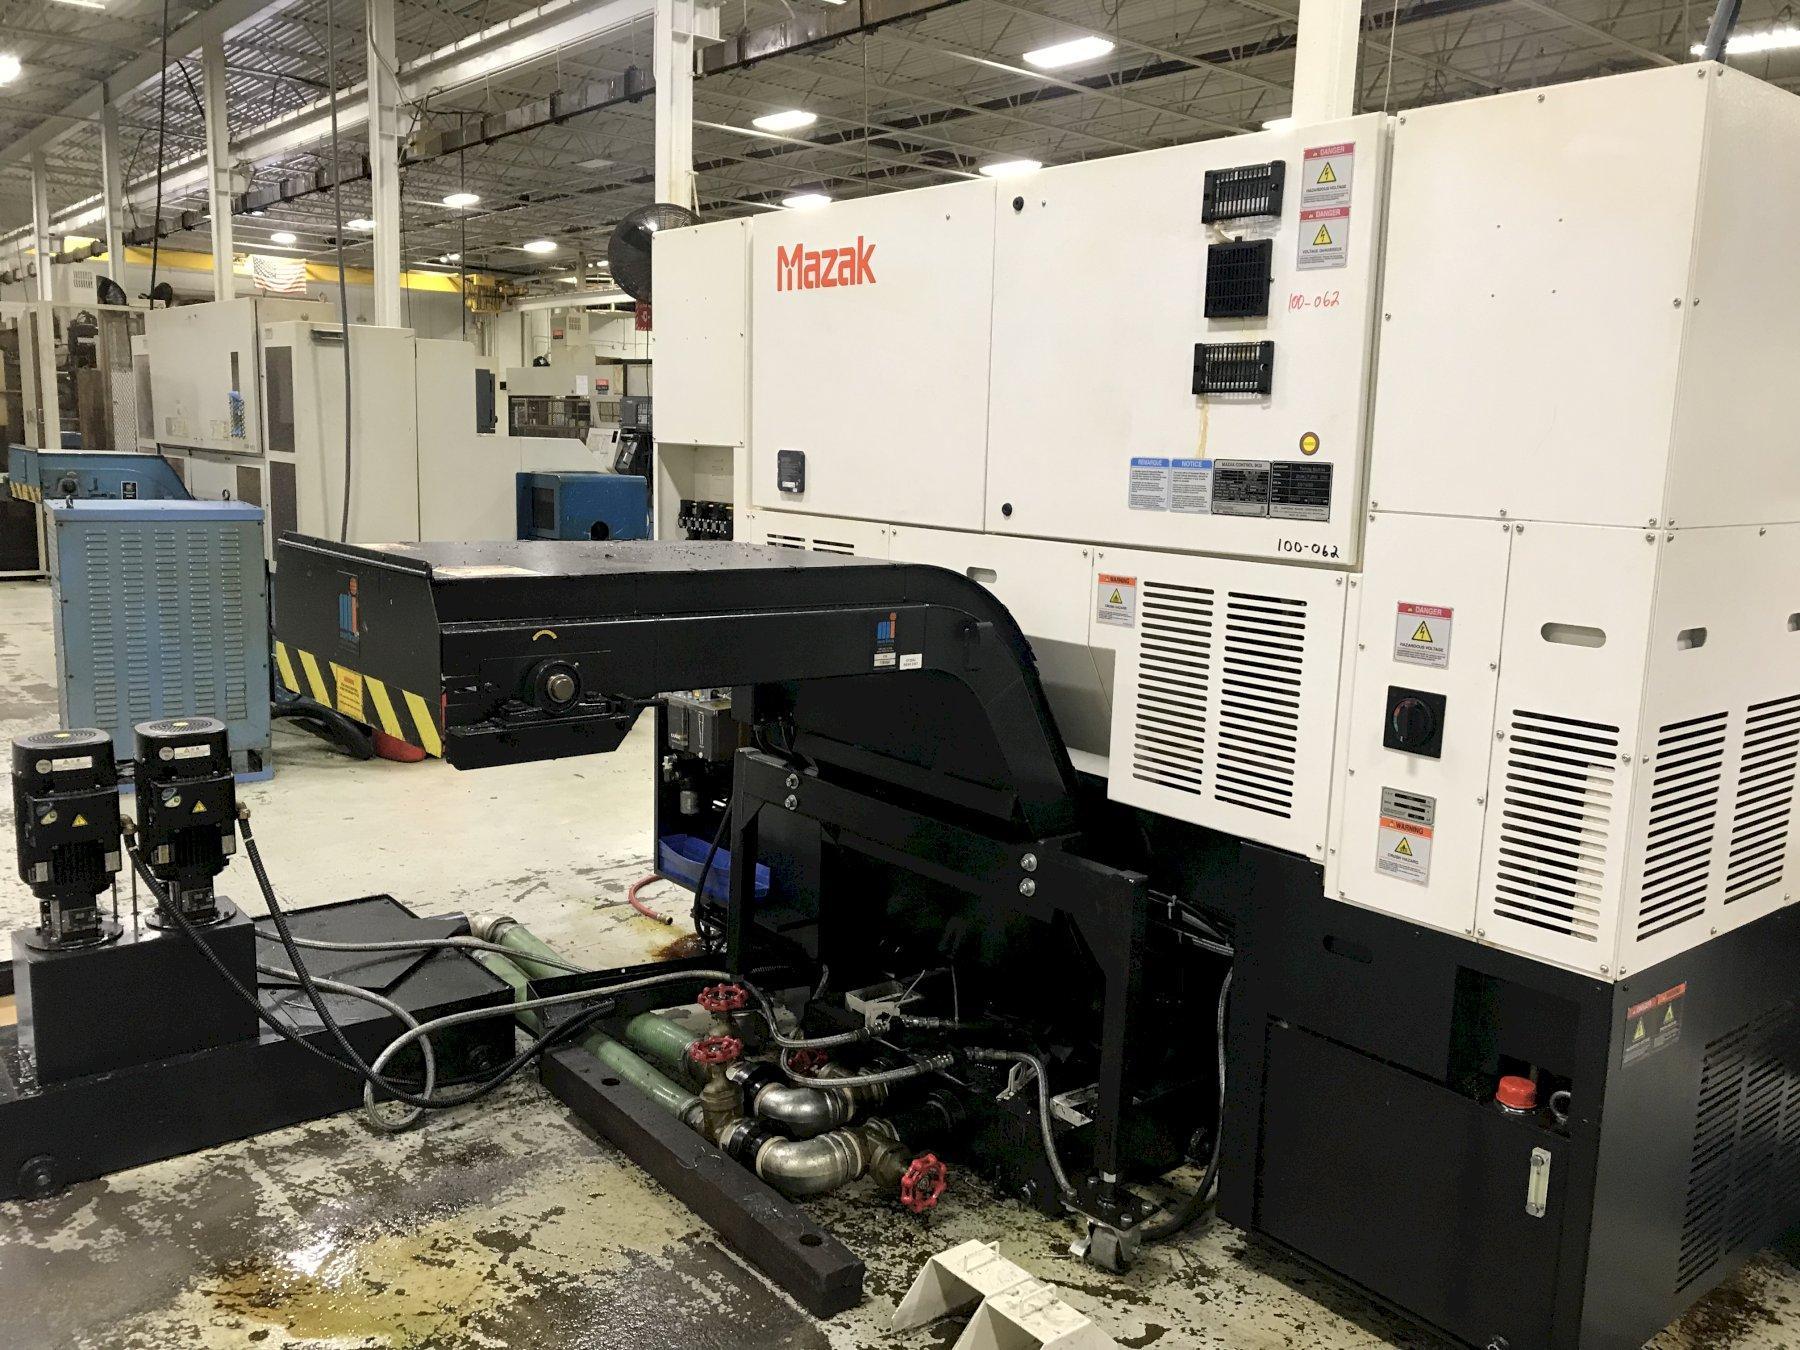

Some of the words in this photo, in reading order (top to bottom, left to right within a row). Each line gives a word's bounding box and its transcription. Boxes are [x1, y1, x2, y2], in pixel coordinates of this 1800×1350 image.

[1320, 146, 1345, 155] DANGER
[1315, 208, 1341, 218] DANGER
[777, 235, 877, 292] Mazak
[1288, 290, 1340, 313] 100-062
[1278, 538, 1340, 559] 100-062
[1415, 605, 1442, 615] DANGER
[1395, 821, 1424, 835] WARNING
